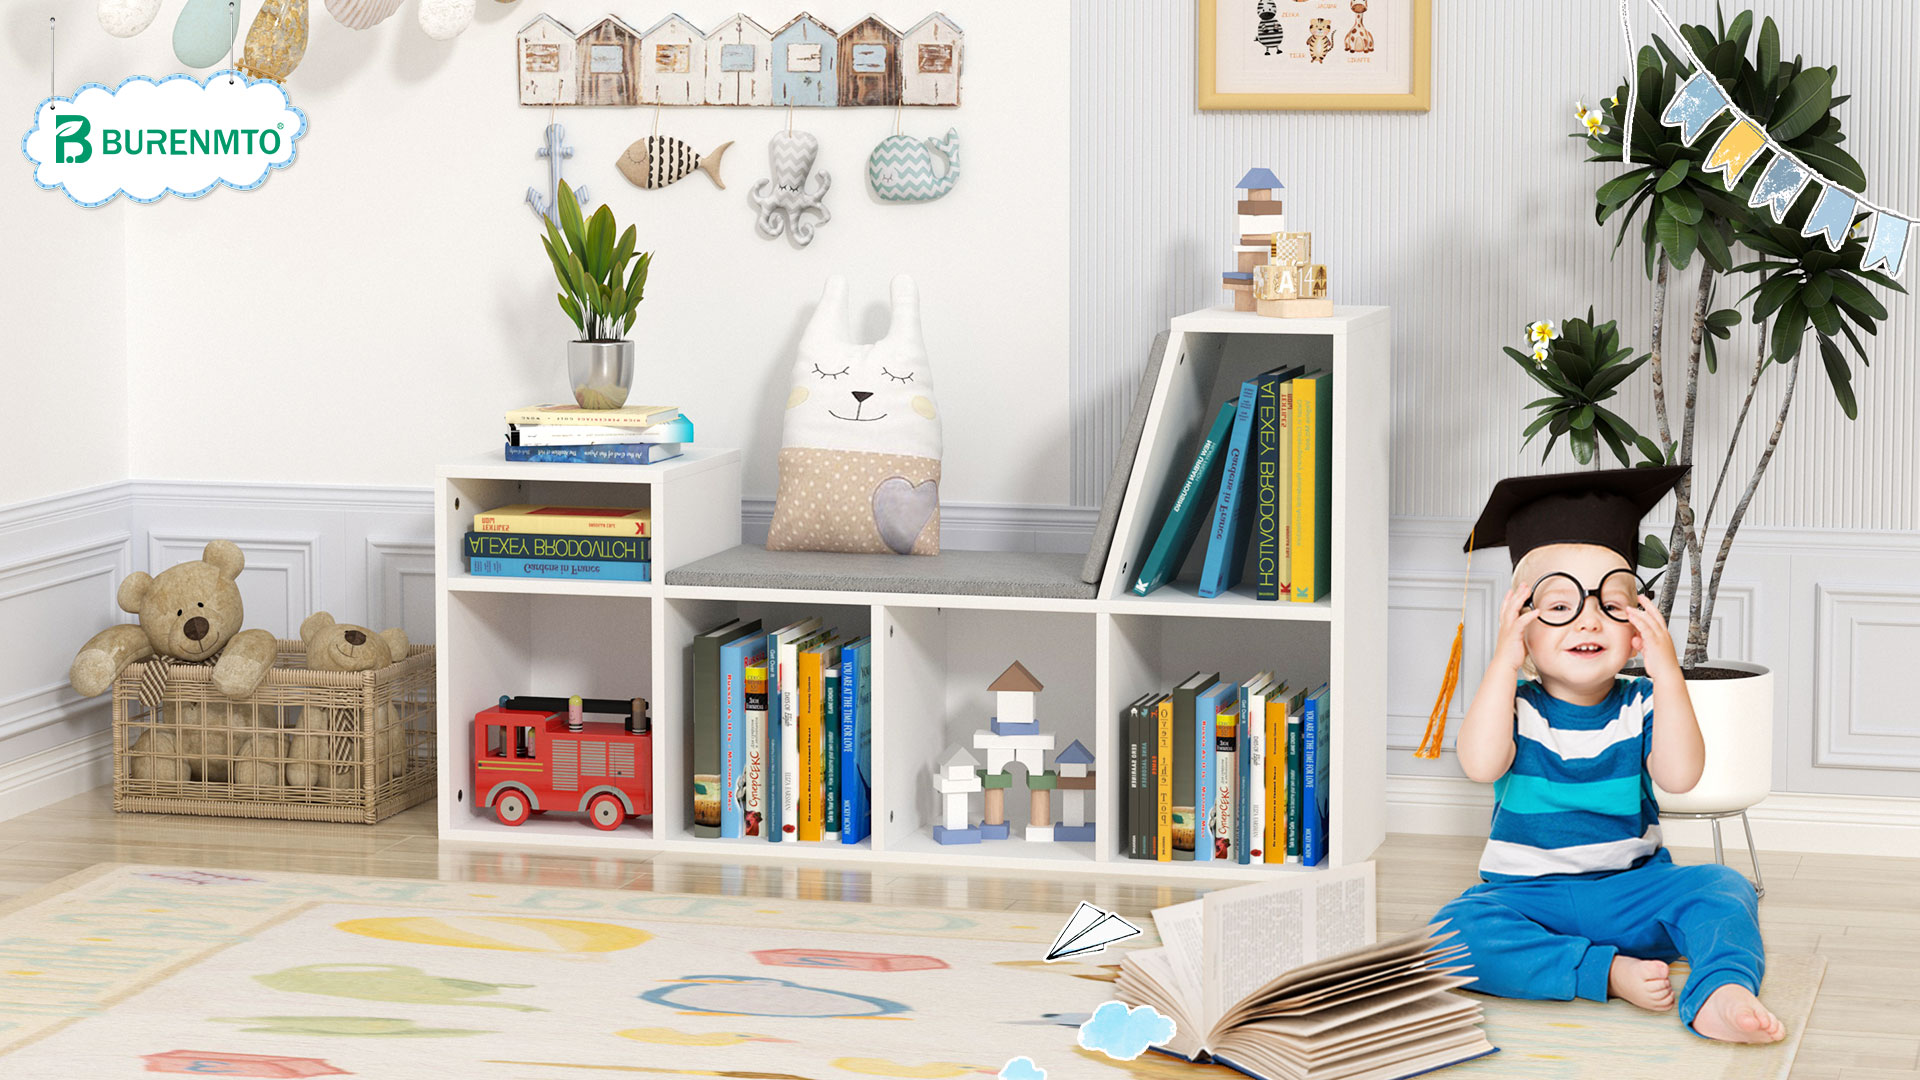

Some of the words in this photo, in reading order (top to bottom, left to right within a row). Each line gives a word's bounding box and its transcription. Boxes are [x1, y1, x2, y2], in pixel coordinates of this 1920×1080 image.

[1278, 270, 1295, 294] A
[843, 661, 853, 675] YOU
[843, 675, 853, 686] ARE
[843, 686, 853, 695] AT
[843, 696, 853, 708] THE
[727, 708, 733, 720] As
[843, 709, 853, 724] TIME
[1306, 710, 1315, 723] YOU
[843, 724, 853, 737] FOR
[1306, 723, 1315, 732] ARE
[843, 737, 853, 753] LOVE
[1306, 739, 1314, 750] THE
[1306, 750, 1314, 764] TIME
[1306, 764, 1314, 774] FOR
[748, 751, 762, 808] СуперСЕКС
[1305, 775, 1314, 788] LOVE
[1218, 786, 1230, 835] СуперСЕКС
